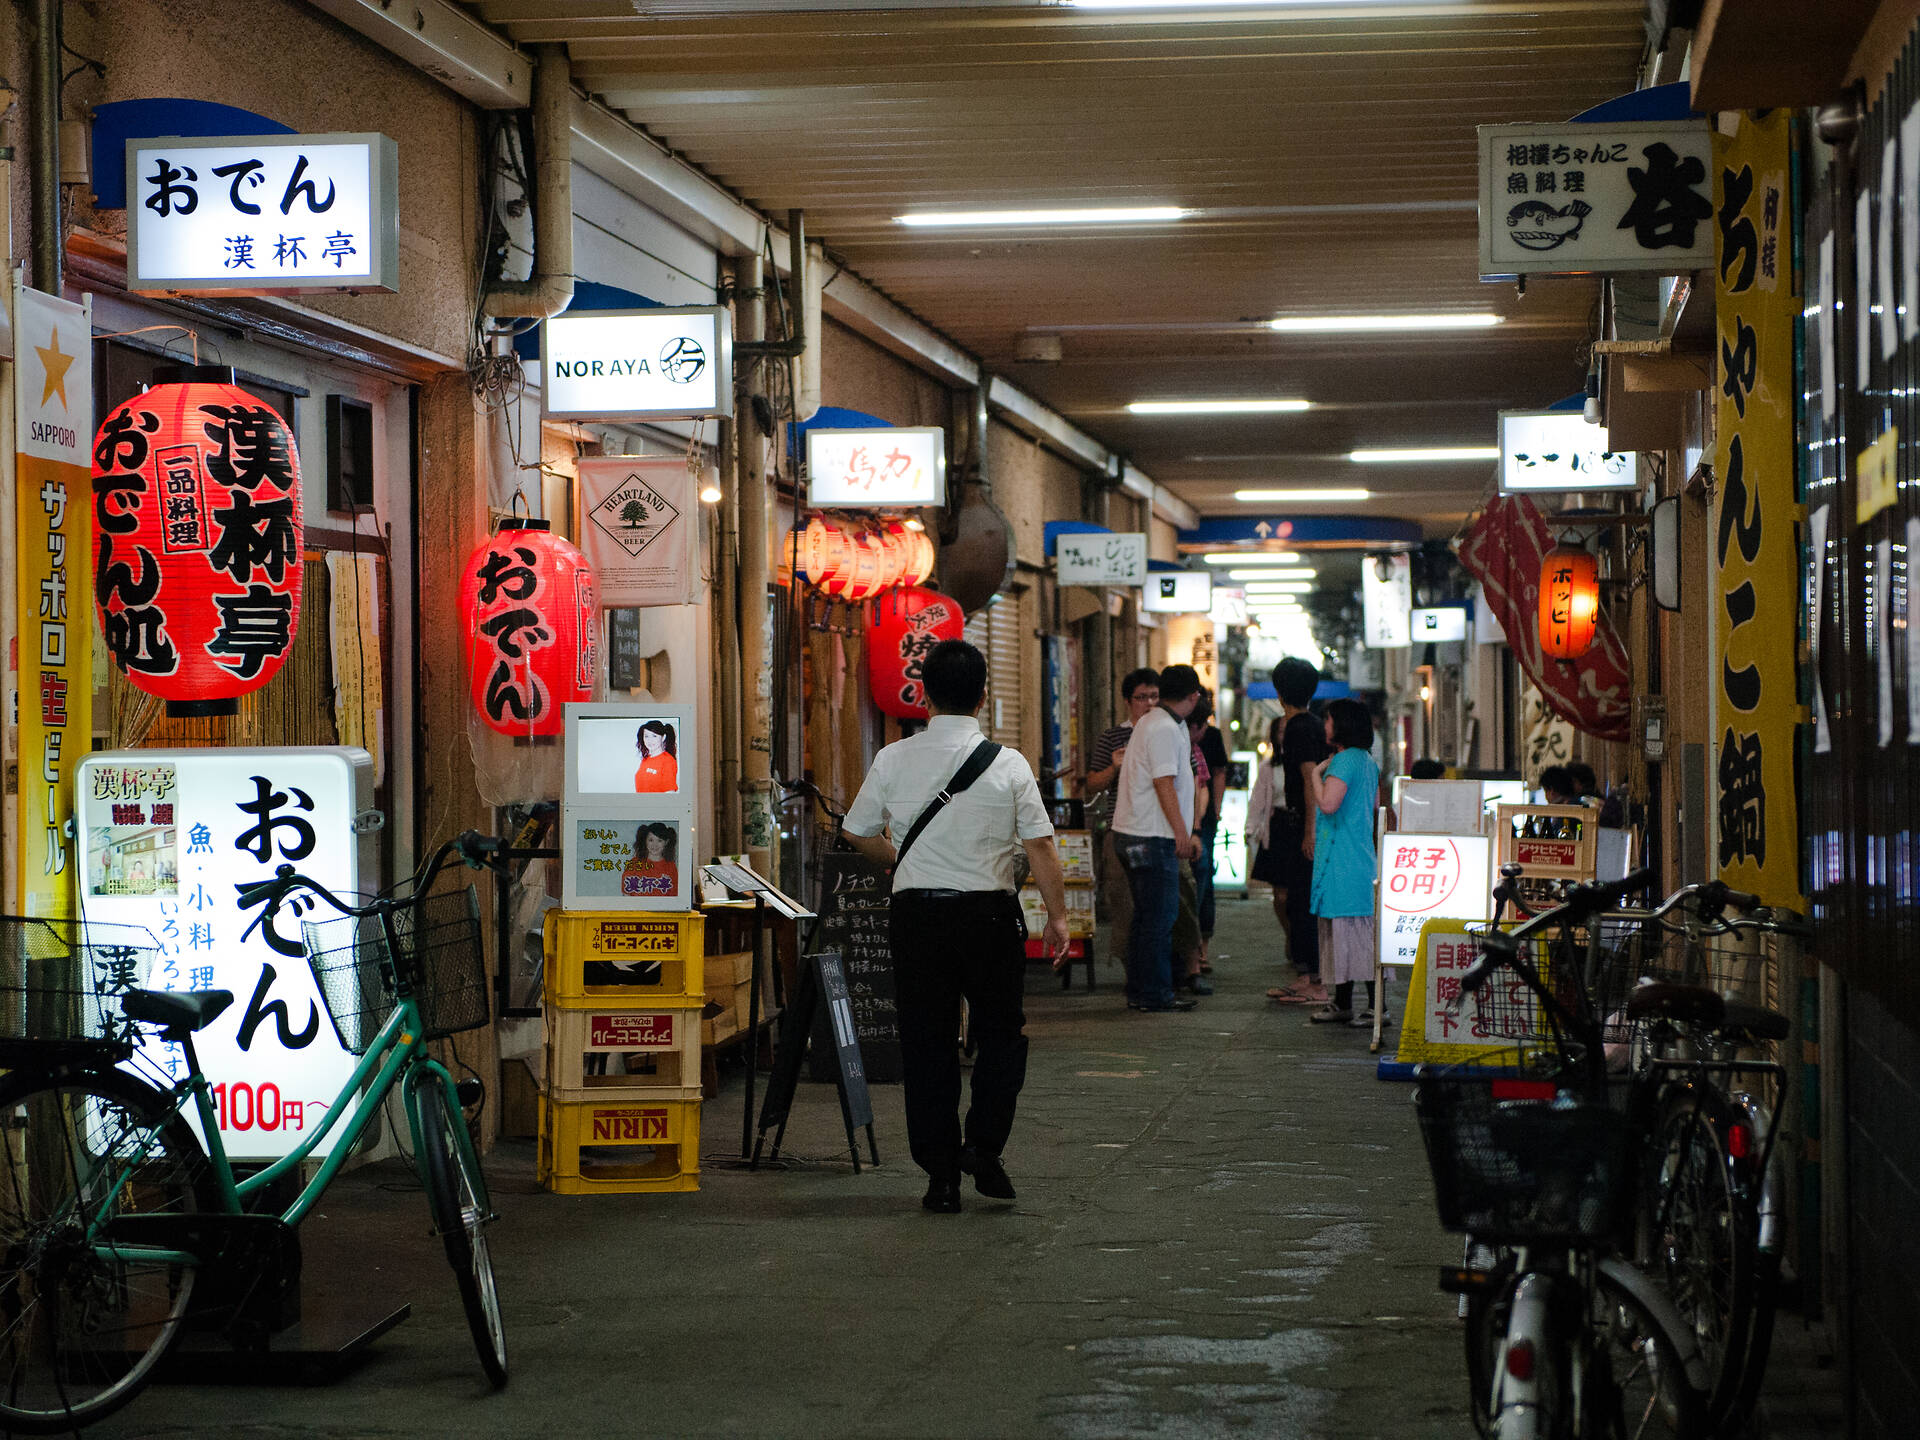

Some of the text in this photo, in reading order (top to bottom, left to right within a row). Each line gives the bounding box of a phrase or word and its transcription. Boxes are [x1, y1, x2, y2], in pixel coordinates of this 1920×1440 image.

[1506, 143, 1629, 167] 相撲ちゃんこ
[144, 155, 336, 218] おでん
[1507, 171, 1585, 194] 魚料理
[1616, 142, 1713, 249] 谷
[223, 229, 357, 270] 漢杯亭
[555, 358, 652, 378] NORAYA
[31, 421, 76, 449] SAPPORO
[844, 446, 913, 491] 馬力
[163, 455, 200, 546] 一品料理
[604, 488, 665, 513] HEARTLAND
[198, 405, 297, 682] 漢杯亭
[1552, 568, 1573, 646] ホッピー
[476, 547, 550, 722] おでん
[39, 479, 68, 876] サッポロ生ビール
[94, 767, 175, 801] 漢杯亭
[583, 828, 619, 840] おいしい
[600, 843, 632, 855] おでん
[1394, 846, 1447, 869] 餃子
[1519, 844, 1575, 857] アサヒビール
[583, 858, 655, 871] ご賞味ください
[624, 873, 674, 894] 漢杯亭
[233, 775, 320, 1052] おでん
[592, 927, 600, 949] 中びん
[602, 924, 676, 932] KIRIN BEER
[603, 936, 675, 950] キリンビール
[592, 1028, 671, 1043] アサヒビール
[593, 1117, 668, 1140] KIRIN
